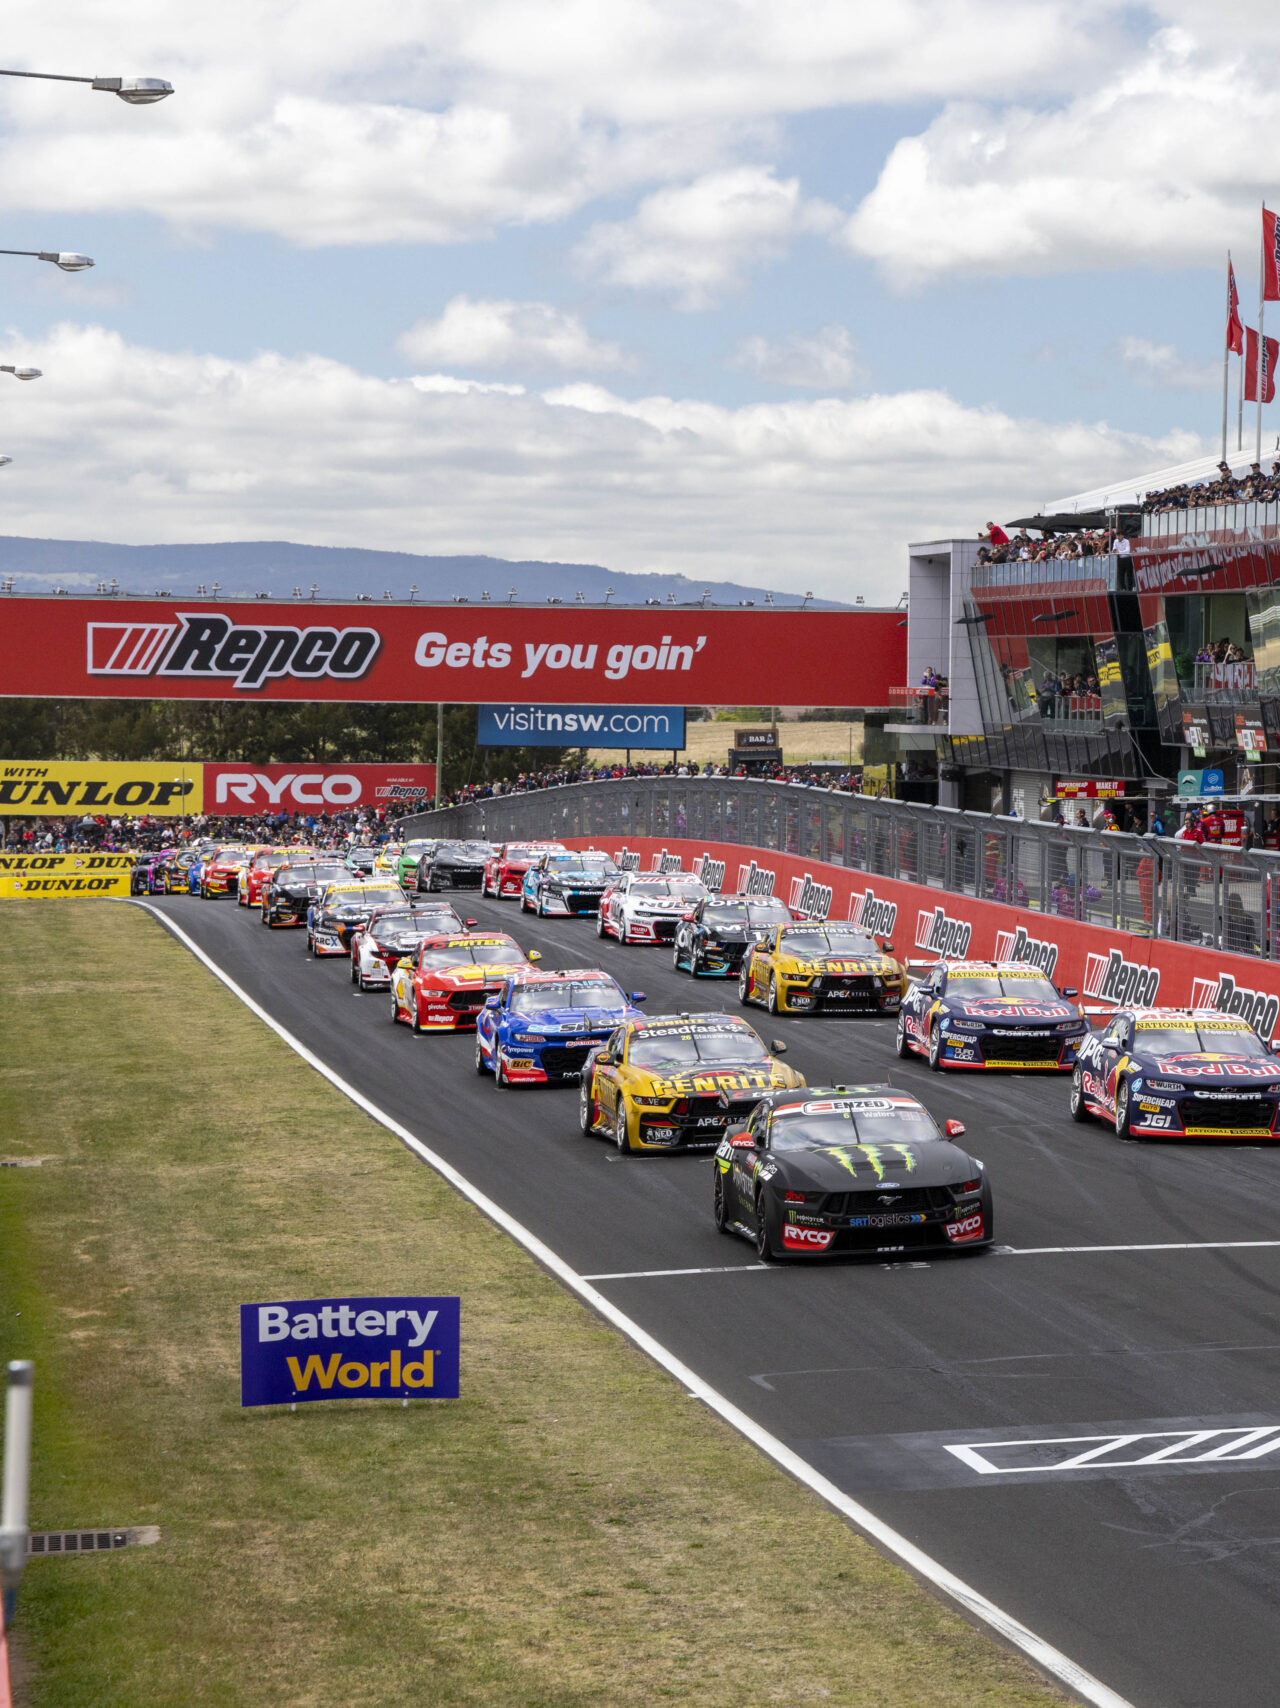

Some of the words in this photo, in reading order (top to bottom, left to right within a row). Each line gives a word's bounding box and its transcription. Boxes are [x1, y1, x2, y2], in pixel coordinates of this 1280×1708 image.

[157, 613, 382, 689] Repco
[414, 632, 512, 670] Gets
[522, 642, 598, 679] you
[605, 633, 708, 680] goin'
[493, 706, 670, 735] visitnsw.com
[749, 735, 765, 743] BAR
[4, 767, 48, 777] WITH
[216, 773, 363, 804] RYCO
[389, 784, 428, 799] Repco
[1096, 782, 1109, 790] MAKE
[1110, 782, 1119, 790] IT
[1097, 790, 1116, 798] SUPER
[24, 878, 119, 891] DUNLOP
[749, 859, 775, 896] Repco
[797, 873, 833, 919] Repco
[709, 899, 783, 908] OPTUS
[861, 888, 897, 937] Repco
[786, 927, 851, 935] Steadfast
[930, 907, 972, 959] Repco
[447, 939, 508, 948] PIRTEK
[1012, 926, 1058, 979] Repco
[796, 961, 892, 974] PENRITE
[1100, 948, 1160, 1007] Repco
[827, 990, 850, 998] APEX
[963, 1006, 1020, 1017] Red
[1021, 1006, 1071, 1017] Bull
[1215, 973, 1280, 1041] Repco
[647, 1018, 706, 1028] PENRITE
[1140, 1013, 1244, 1022] AMPOL
[637, 1024, 725, 1039] Steadfast
[1137, 1022, 1194, 1030] NATIONAL
[1196, 1022, 1250, 1031] STORAGE
[941, 1030, 977, 1044] SUPERCHEAP
[507, 1045, 534, 1054] Tyrepower
[1158, 1062, 1224, 1076] Red
[650, 1072, 786, 1098] PENRITE
[635, 1096, 660, 1106] GROVE
[834, 1099, 885, 1111] ENZED
[1132, 1092, 1176, 1109] SUPERCHEAP
[697, 1115, 728, 1127] APEX
[864, 1110, 895, 1118] Waters
[1140, 1113, 1172, 1128] JGI
[731, 1140, 755, 1148] RYCO
[946, 1215, 982, 1237] RYCO
[784, 1224, 831, 1245] RYCO
[258, 1305, 439, 1348] Battery
[286, 1350, 434, 1392] World
